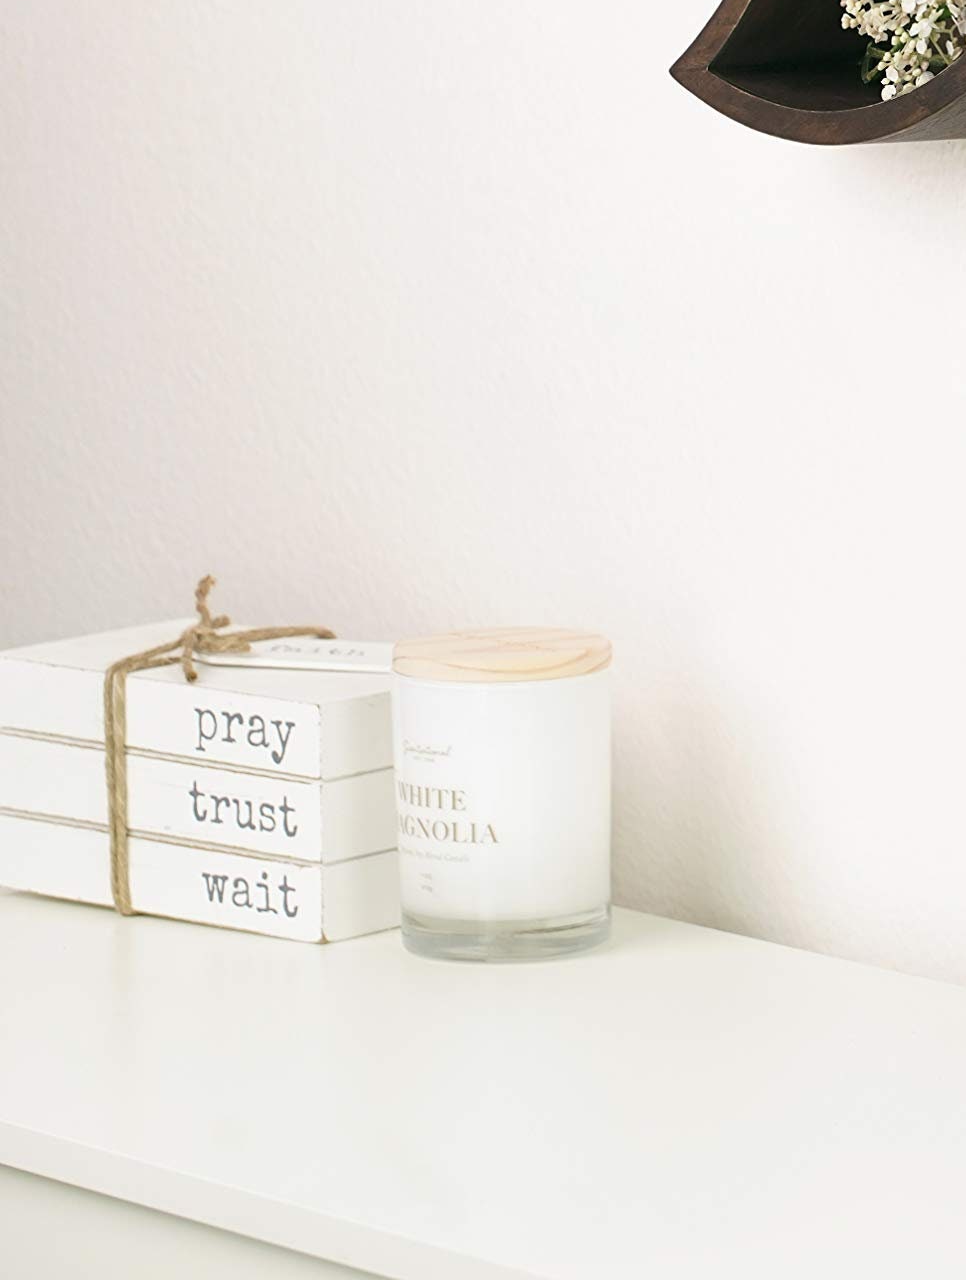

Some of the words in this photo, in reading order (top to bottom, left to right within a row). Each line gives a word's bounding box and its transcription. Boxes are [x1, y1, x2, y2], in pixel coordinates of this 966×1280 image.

[194, 707, 296, 765] pray
[188, 780, 298, 838] trust
[398, 780, 467, 811] WHITE
[201, 871, 299, 918] wait
